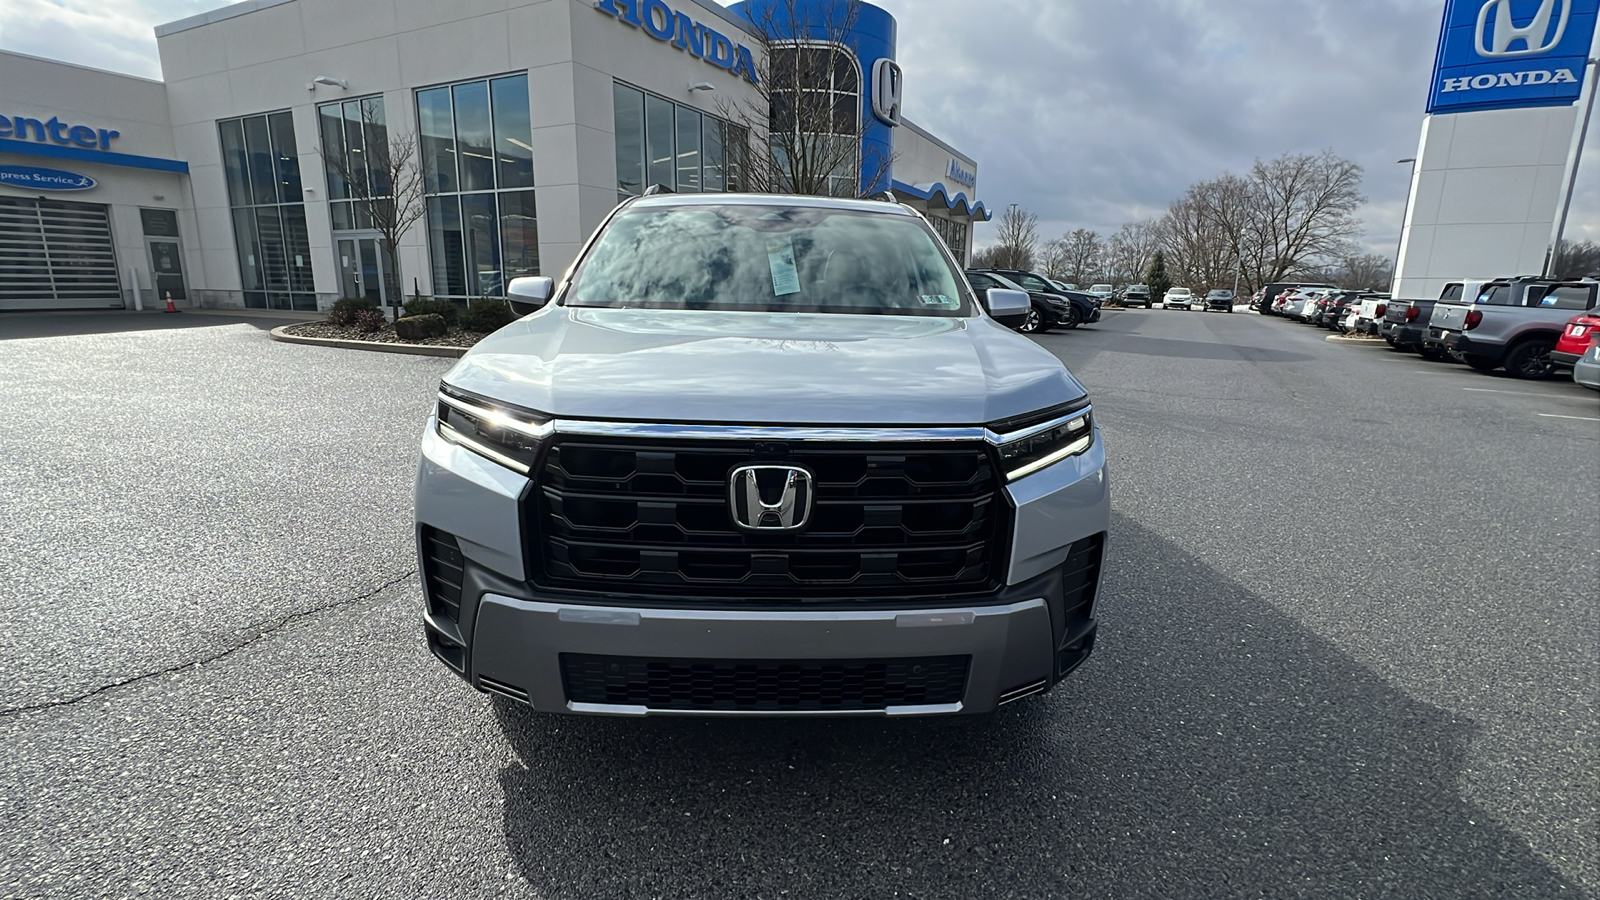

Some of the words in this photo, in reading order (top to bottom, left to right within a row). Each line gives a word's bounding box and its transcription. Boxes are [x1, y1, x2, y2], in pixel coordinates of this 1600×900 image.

[595, 0, 760, 84] HONDA
[1441, 68, 1578, 93] HONDA
[33, 173, 74, 184] Service
